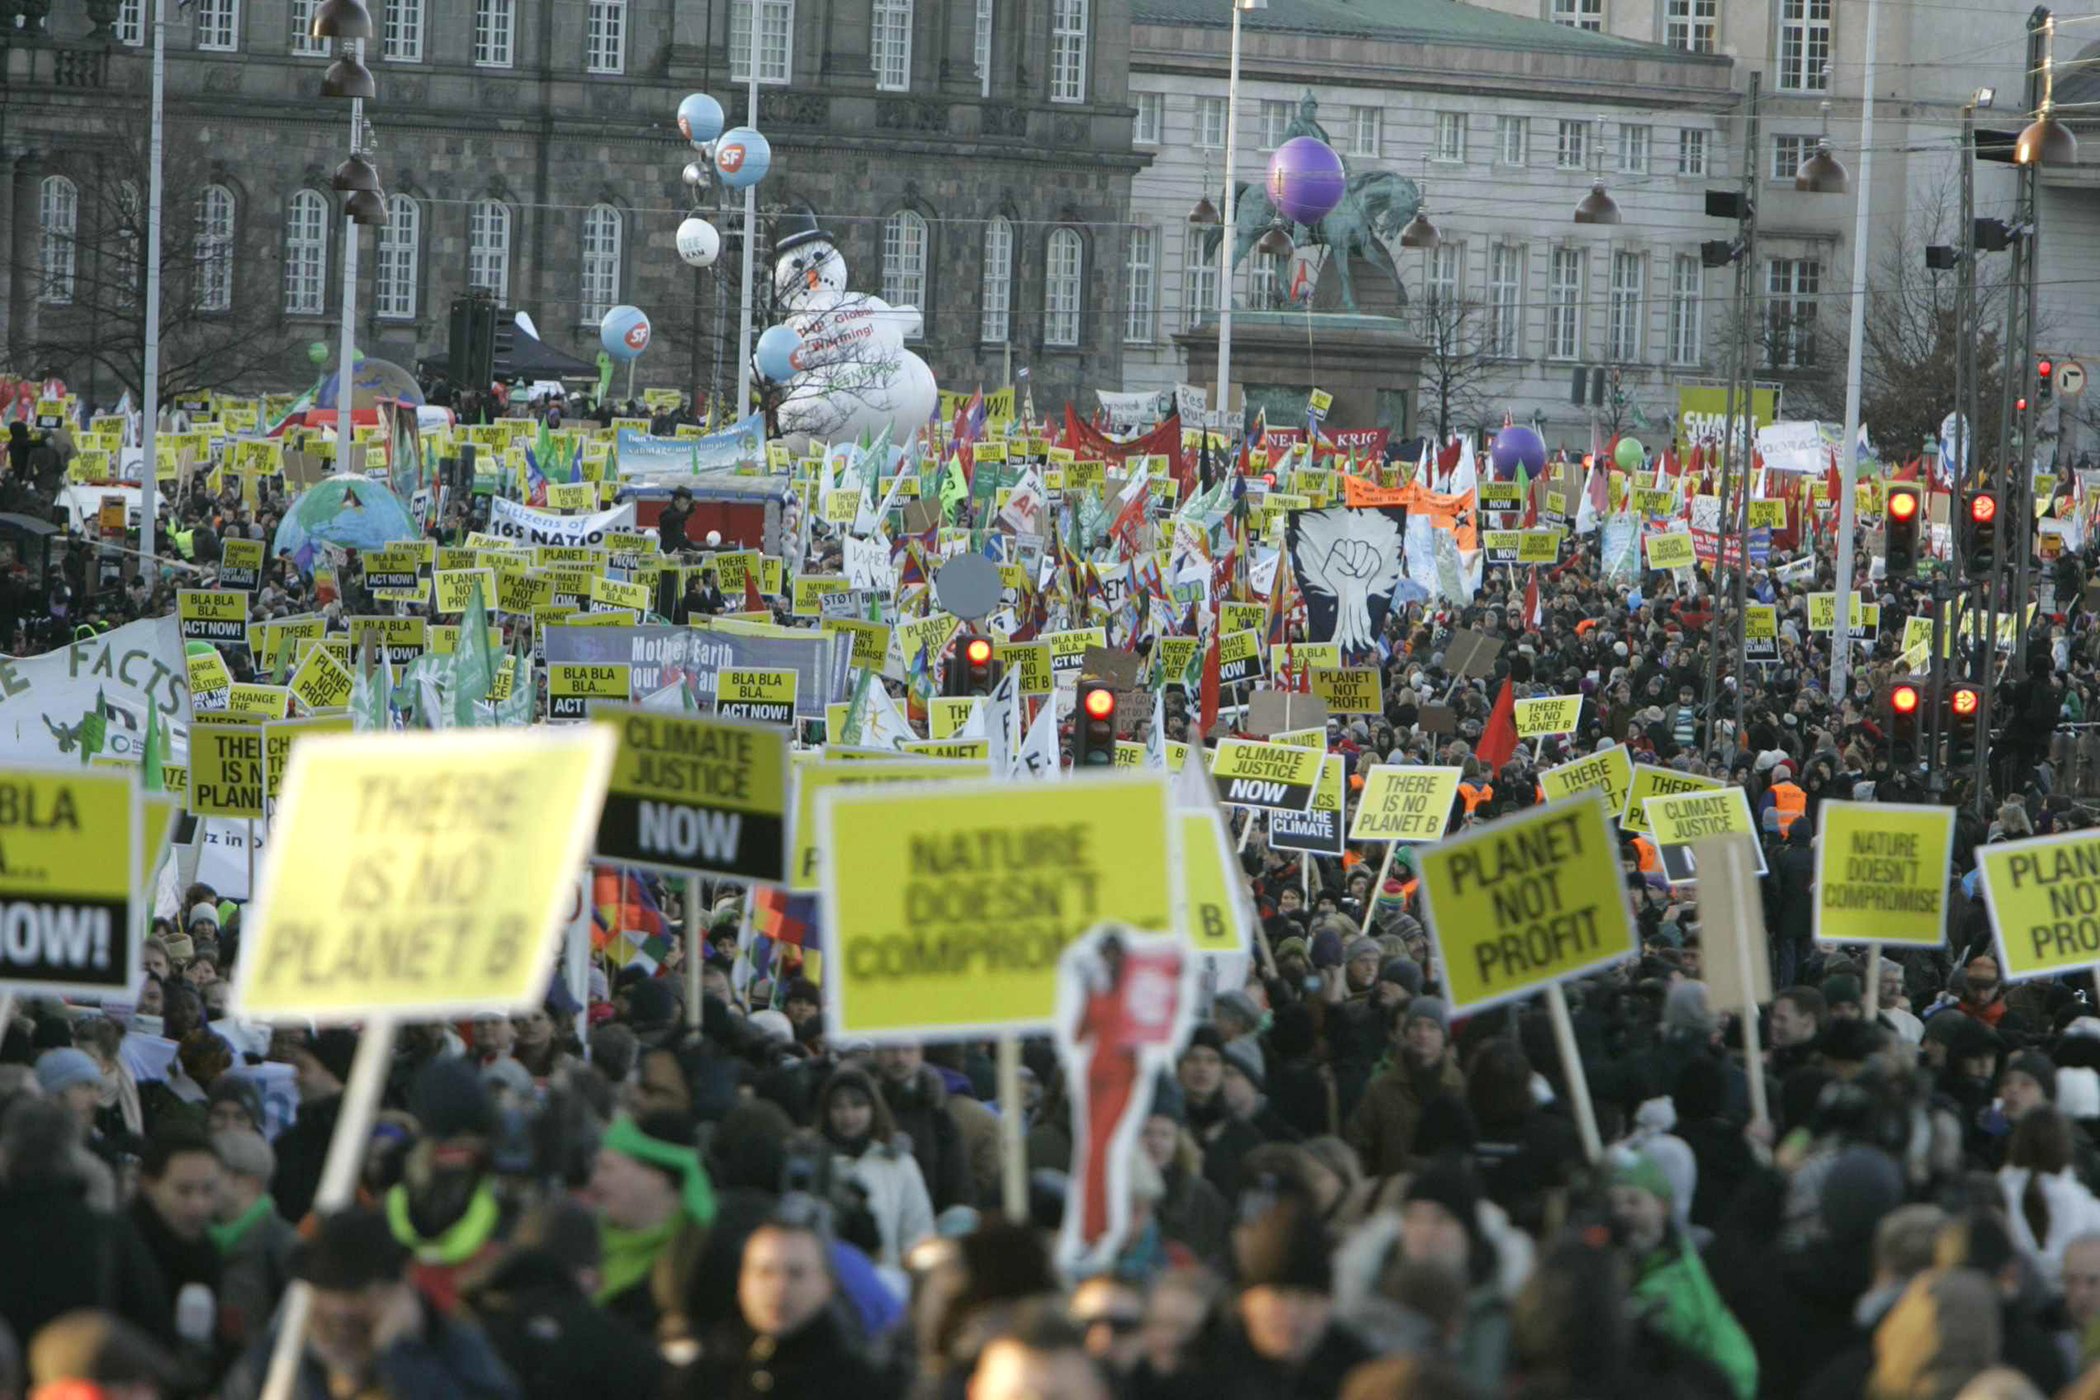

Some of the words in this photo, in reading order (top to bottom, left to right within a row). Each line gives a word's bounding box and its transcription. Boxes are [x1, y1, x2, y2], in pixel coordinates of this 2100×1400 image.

[721, 149, 743, 166] SF
[630, 327, 648, 344] SF
[1336, 431, 1378, 447] KRIG
[557, 487, 584, 497] THERE
[1489, 499, 1512, 509] NOW
[494, 500, 561, 529] Citizens
[568, 515, 588, 532] of
[492, 520, 524, 539] 165
[372, 553, 389, 562] BLA
[390, 553, 407, 562] BLA
[486, 555, 500, 565] BLA
[503, 557, 519, 567] BLA
[544, 549, 584, 560] PLANET
[716, 556, 748, 568] THERE
[369, 574, 387, 585] ACT
[388, 573, 414, 585] NOW!
[720, 569, 730, 578] IS
[502, 575, 548, 593] PLANET
[601, 582, 618, 593] BLA
[620, 585, 638, 597] BLA
[190, 593, 213, 605] BLA
[214, 593, 235, 606] BLA
[511, 587, 536, 601] NOT
[556, 594, 577, 605] OW
[183, 620, 208, 636] ACT
[208, 620, 242, 637] NOW!
[389, 620, 411, 631] BLA
[906, 615, 952, 638] PLANET
[1051, 635, 1071, 644] BLA
[1073, 632, 1094, 642] BLA
[631, 635, 688, 661] Mother
[693, 642, 733, 668] Earth
[1004, 647, 1039, 662] THERE
[1163, 641, 1193, 654] THERE
[1307, 647, 1327, 658] BLA
[1053, 655, 1072, 668] ACT
[1173, 655, 1187, 666] NO
[69, 639, 188, 716] FACTS
[563, 667, 589, 680] BLA
[590, 667, 615, 680] BLA
[630, 667, 659, 689] our
[731, 672, 756, 685] BLA
[758, 672, 782, 686] BLA
[1319, 671, 1371, 684] PLANET
[192, 676, 228, 691] OLITICS
[315, 677, 341, 700] NOT
[1041, 677, 1050, 690] B
[1333, 684, 1359, 697] NOT
[230, 691, 277, 705] CHANGE
[554, 698, 583, 714] ACT
[1529, 700, 1566, 713] THERE
[721, 704, 749, 719] ACT
[750, 704, 788, 720] NOW!
[1528, 712, 1541, 723] IS
[1543, 711, 1561, 722] NO
[1517, 720, 1560, 733] PLANET
[1563, 720, 1571, 730] B
[214, 735, 262, 759] THE
[627, 715, 752, 764] CLIMATE
[1235, 745, 1306, 766] CLIMATE
[221, 761, 242, 784] IS
[630, 752, 751, 799] JUSTICE
[1231, 760, 1299, 780] JUSTICE
[1560, 758, 1612, 789] THERE
[1228, 778, 1289, 803] NOW
[1386, 774, 1439, 795] THERE
[197, 783, 262, 809] PLAN
[1382, 795, 1400, 813] IS
[1402, 795, 1427, 813] NO
[0, 783, 80, 833] BLA
[1304, 809, 1332, 825] THE
[1664, 796, 1731, 820] CLIMATE
[638, 800, 742, 863] NOW
[1273, 818, 1334, 838] CLIMATE
[1359, 814, 1423, 834] PLANET
[1426, 816, 1439, 833] B
[1673, 815, 1734, 839] JUSTICE
[225, 830, 243, 848] in
[1851, 829, 1919, 858] NATURE
[908, 822, 1092, 876] NATURE
[1446, 813, 1585, 896] PLANET
[1846, 857, 1919, 883] DOESN'T
[2008, 842, 2100, 889] PLAN
[905, 870, 1099, 926] DOESN'T
[1491, 869, 1564, 930] NOT
[1824, 884, 1941, 914] COMPROMISE
[1199, 902, 1227, 938] B
[0, 900, 111, 971] OW!
[2030, 916, 2100, 960] PRO
[264, 912, 472, 986] PLANET
[1473, 905, 1601, 985] PROFIT
